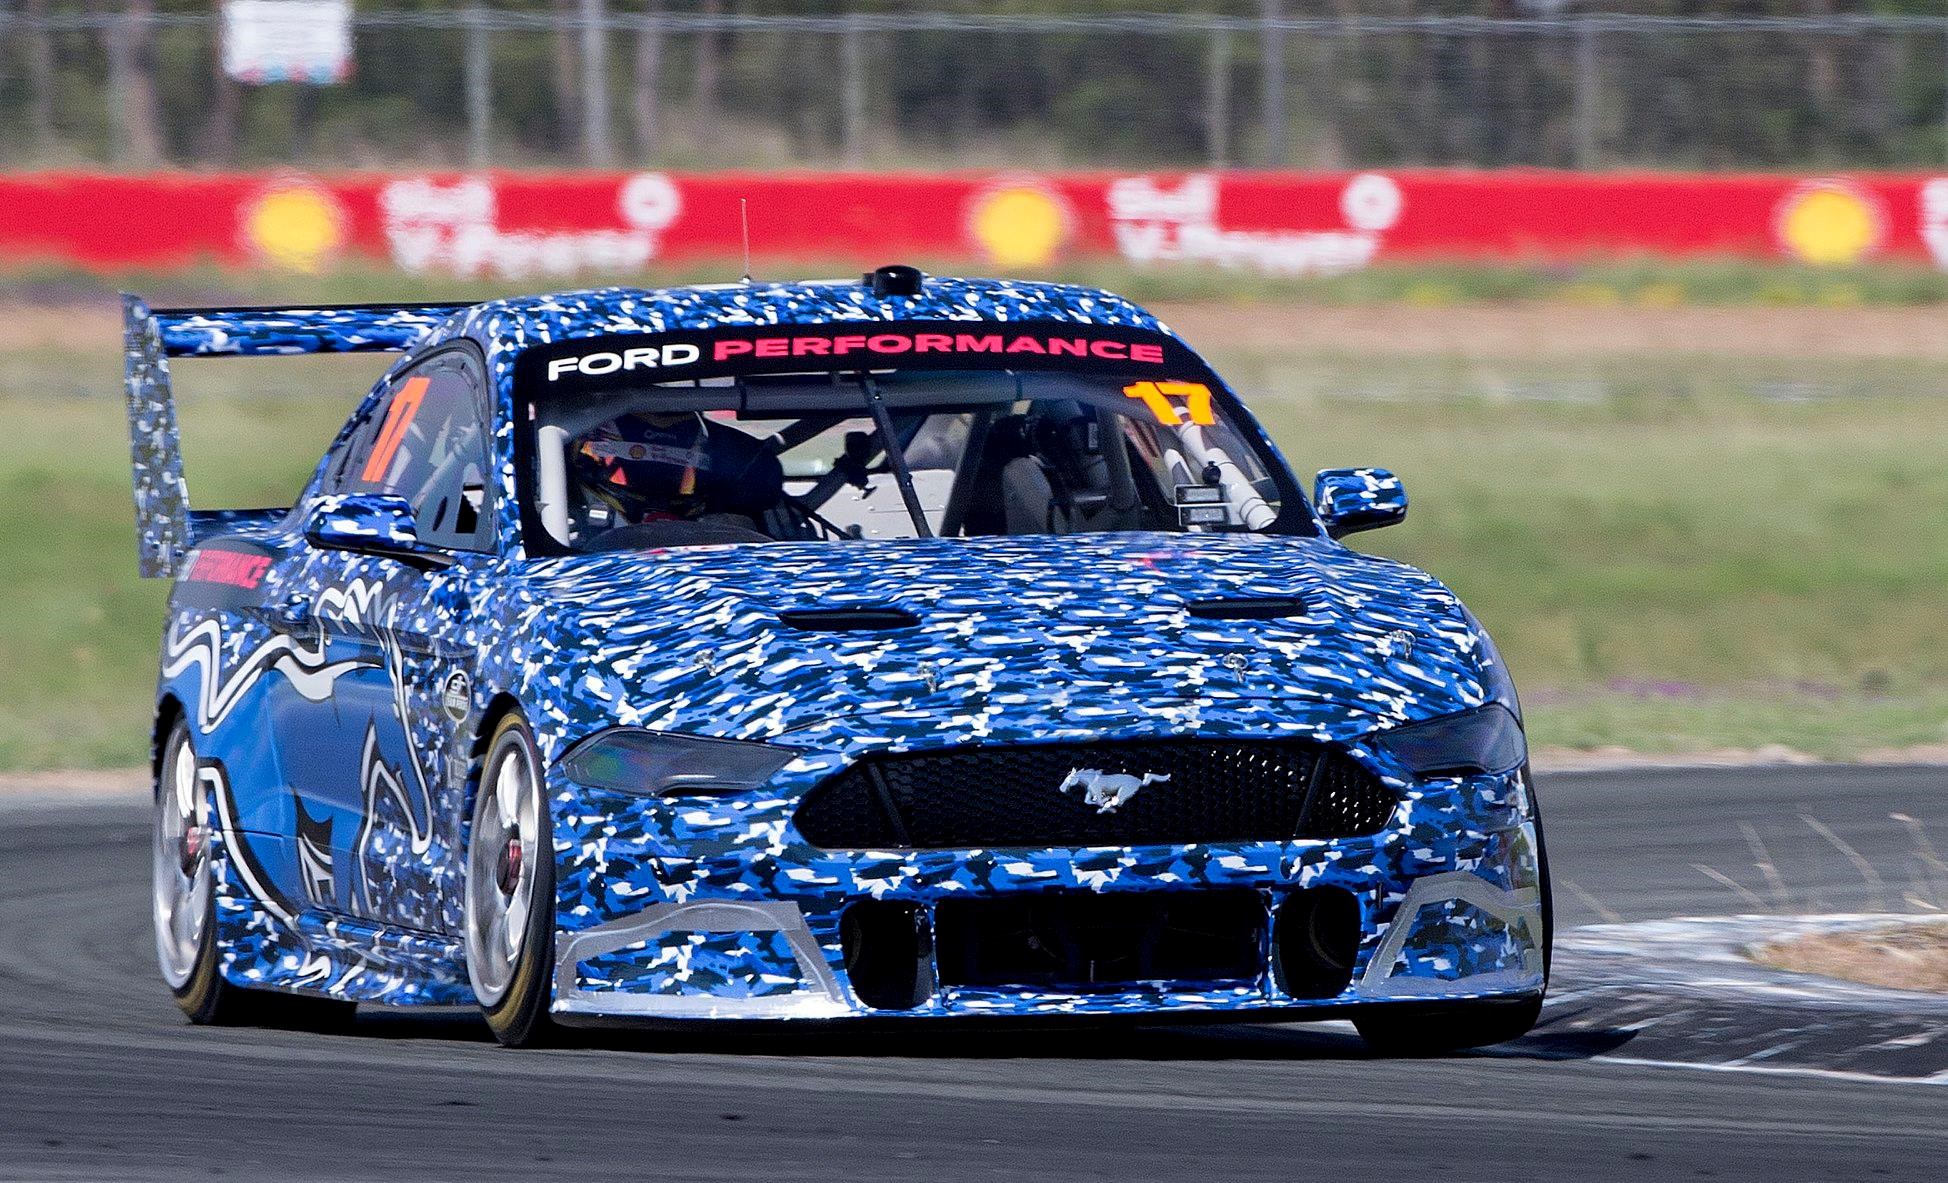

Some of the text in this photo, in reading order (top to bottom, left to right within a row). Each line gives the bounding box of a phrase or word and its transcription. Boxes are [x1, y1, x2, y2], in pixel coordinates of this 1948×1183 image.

[548, 335, 1164, 381] FORD PERFORMANCE
[1123, 381, 1215, 425] 17
